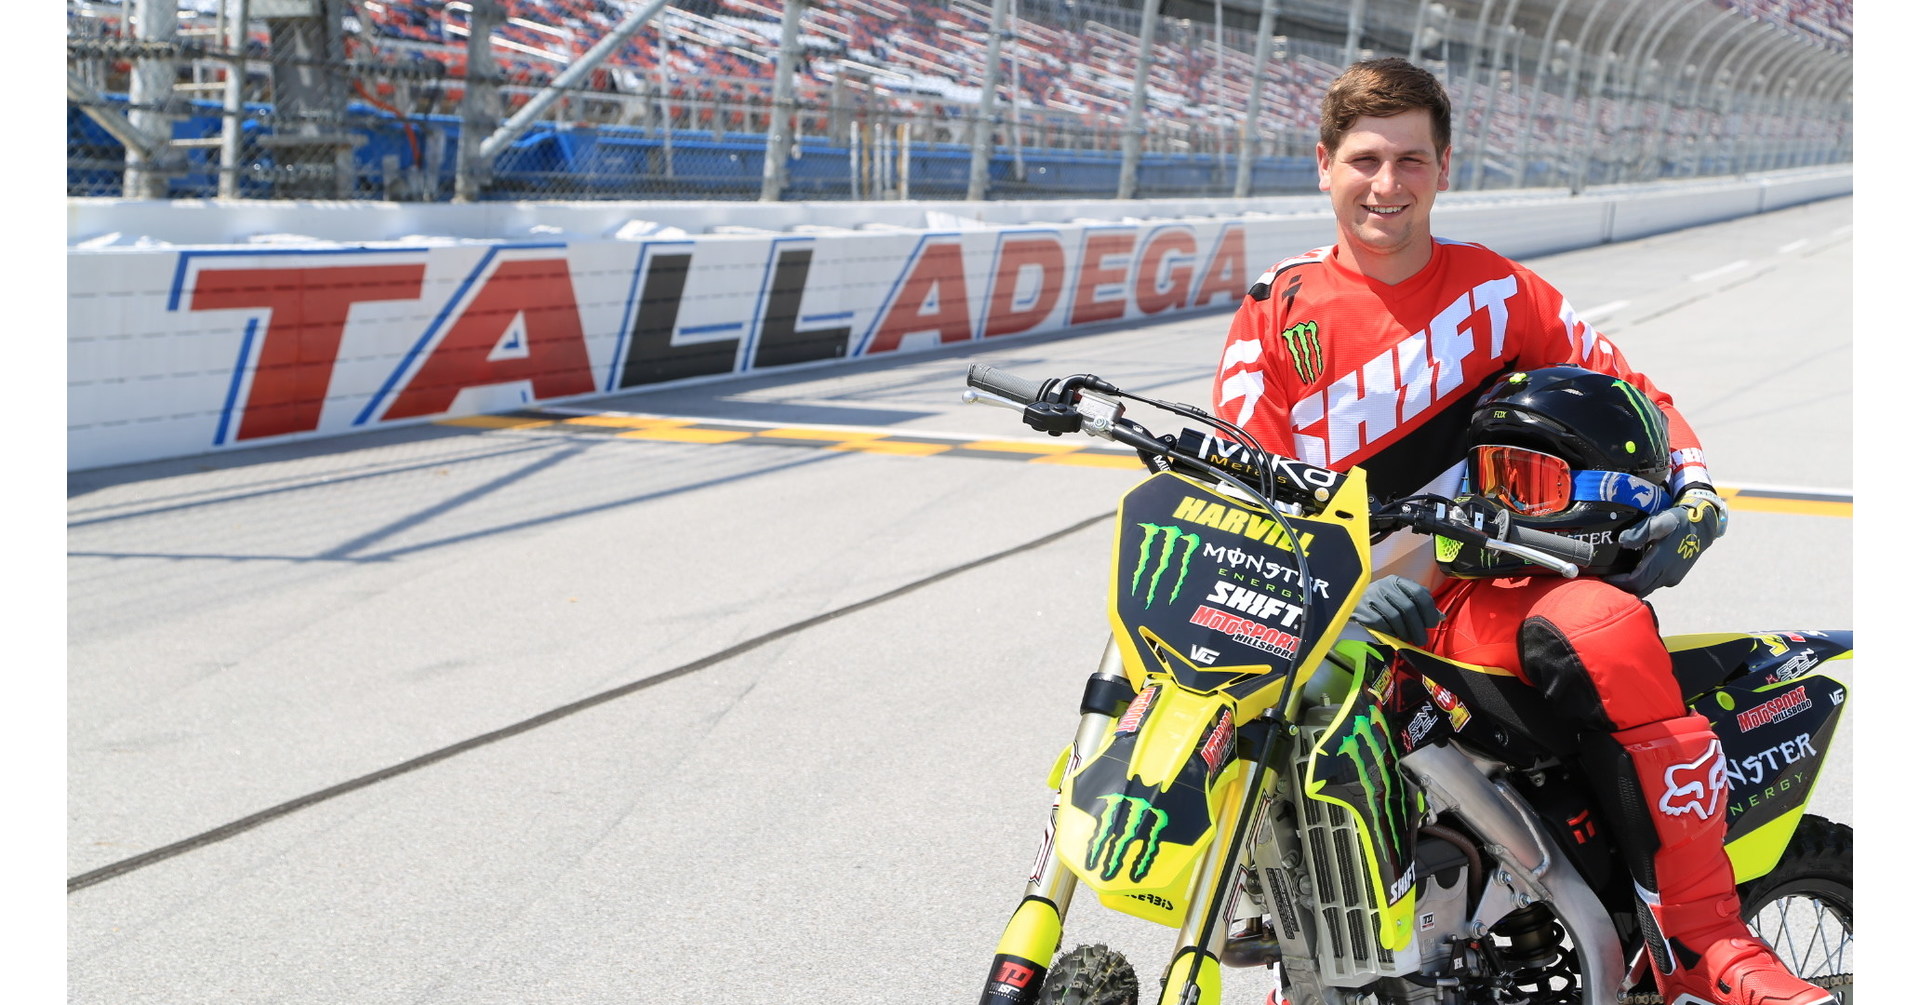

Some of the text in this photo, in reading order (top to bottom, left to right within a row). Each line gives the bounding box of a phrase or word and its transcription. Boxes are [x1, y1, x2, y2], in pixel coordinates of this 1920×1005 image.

[174, 224, 1247, 443] TALLADEGA
[1289, 274, 1518, 469] SHIFT
[1493, 410, 1508, 419] FOX
[1211, 454, 1288, 484] Mets
[1172, 496, 1315, 557] HARVILL
[1206, 580, 1303, 630] SHIFT
[1218, 568, 1305, 602] ENERGY
[1190, 644, 1220, 665] VG
[1736, 685, 1808, 733] MOTOSPORT
[1772, 699, 1813, 724] HILLSBORO
[1829, 688, 1844, 705] VG
[1724, 732, 1817, 791] NSTER
[1730, 772, 1803, 816] NERGY
[1389, 860, 1416, 905] SHIFT
